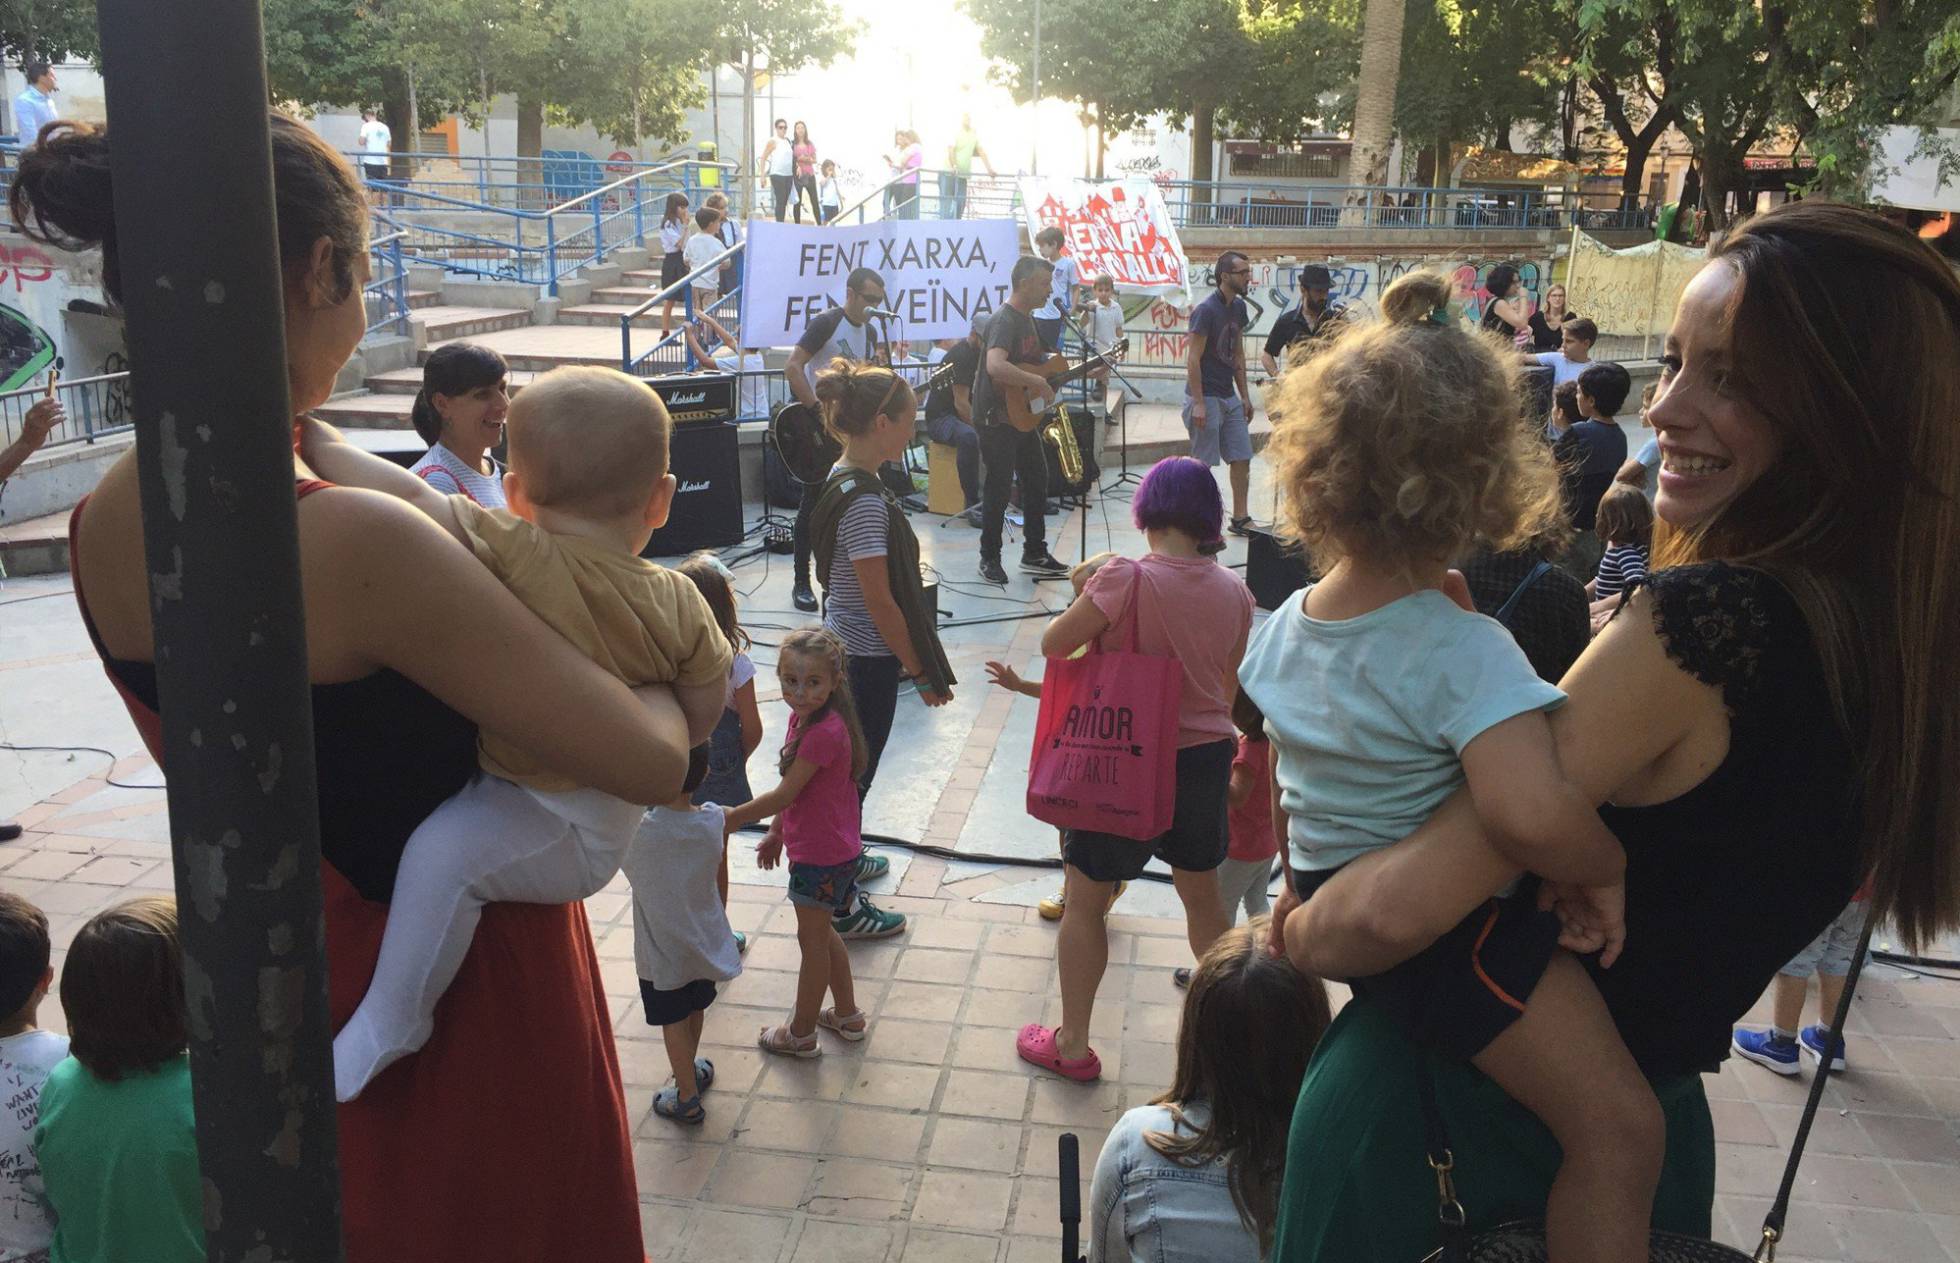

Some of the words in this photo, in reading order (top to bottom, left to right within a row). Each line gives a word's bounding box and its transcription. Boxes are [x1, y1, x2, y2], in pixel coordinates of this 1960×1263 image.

[799, 240, 869, 277] FENT
[878, 236, 997, 275] XARXA,
[666, 391, 706, 405] Marshall
[677, 480, 711, 493] Marshall
[1062, 704, 1133, 741] AMOR
